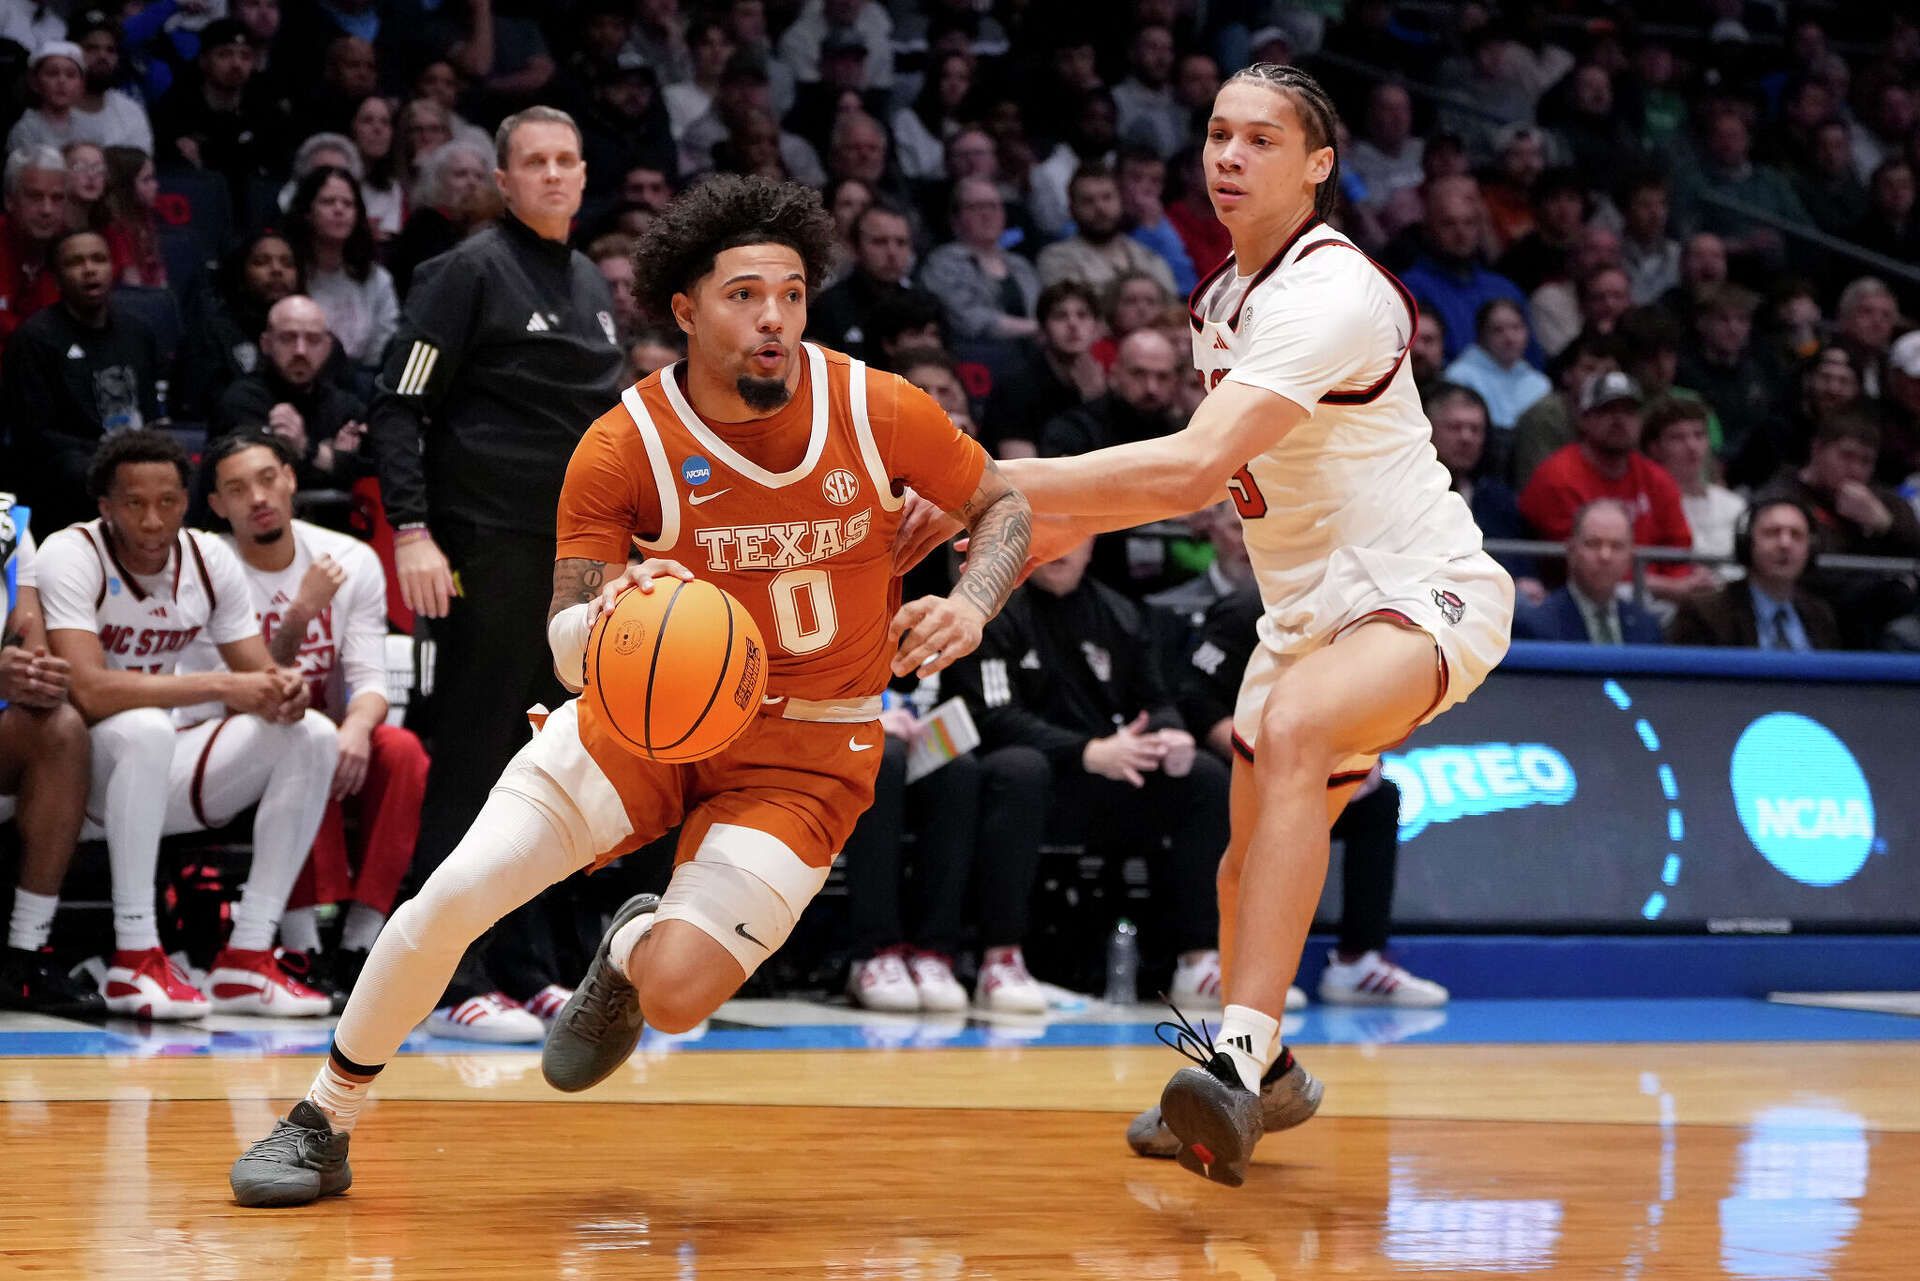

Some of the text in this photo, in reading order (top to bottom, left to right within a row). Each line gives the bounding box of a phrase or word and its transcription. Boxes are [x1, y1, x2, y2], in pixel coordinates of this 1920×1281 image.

[686, 468, 710, 480] NCAA
[824, 471, 857, 504] SEC
[694, 507, 872, 573] TEXAS
[767, 569, 839, 656] 0
[99, 623, 135, 655] NC
[1755, 797, 1875, 840] NCAA
